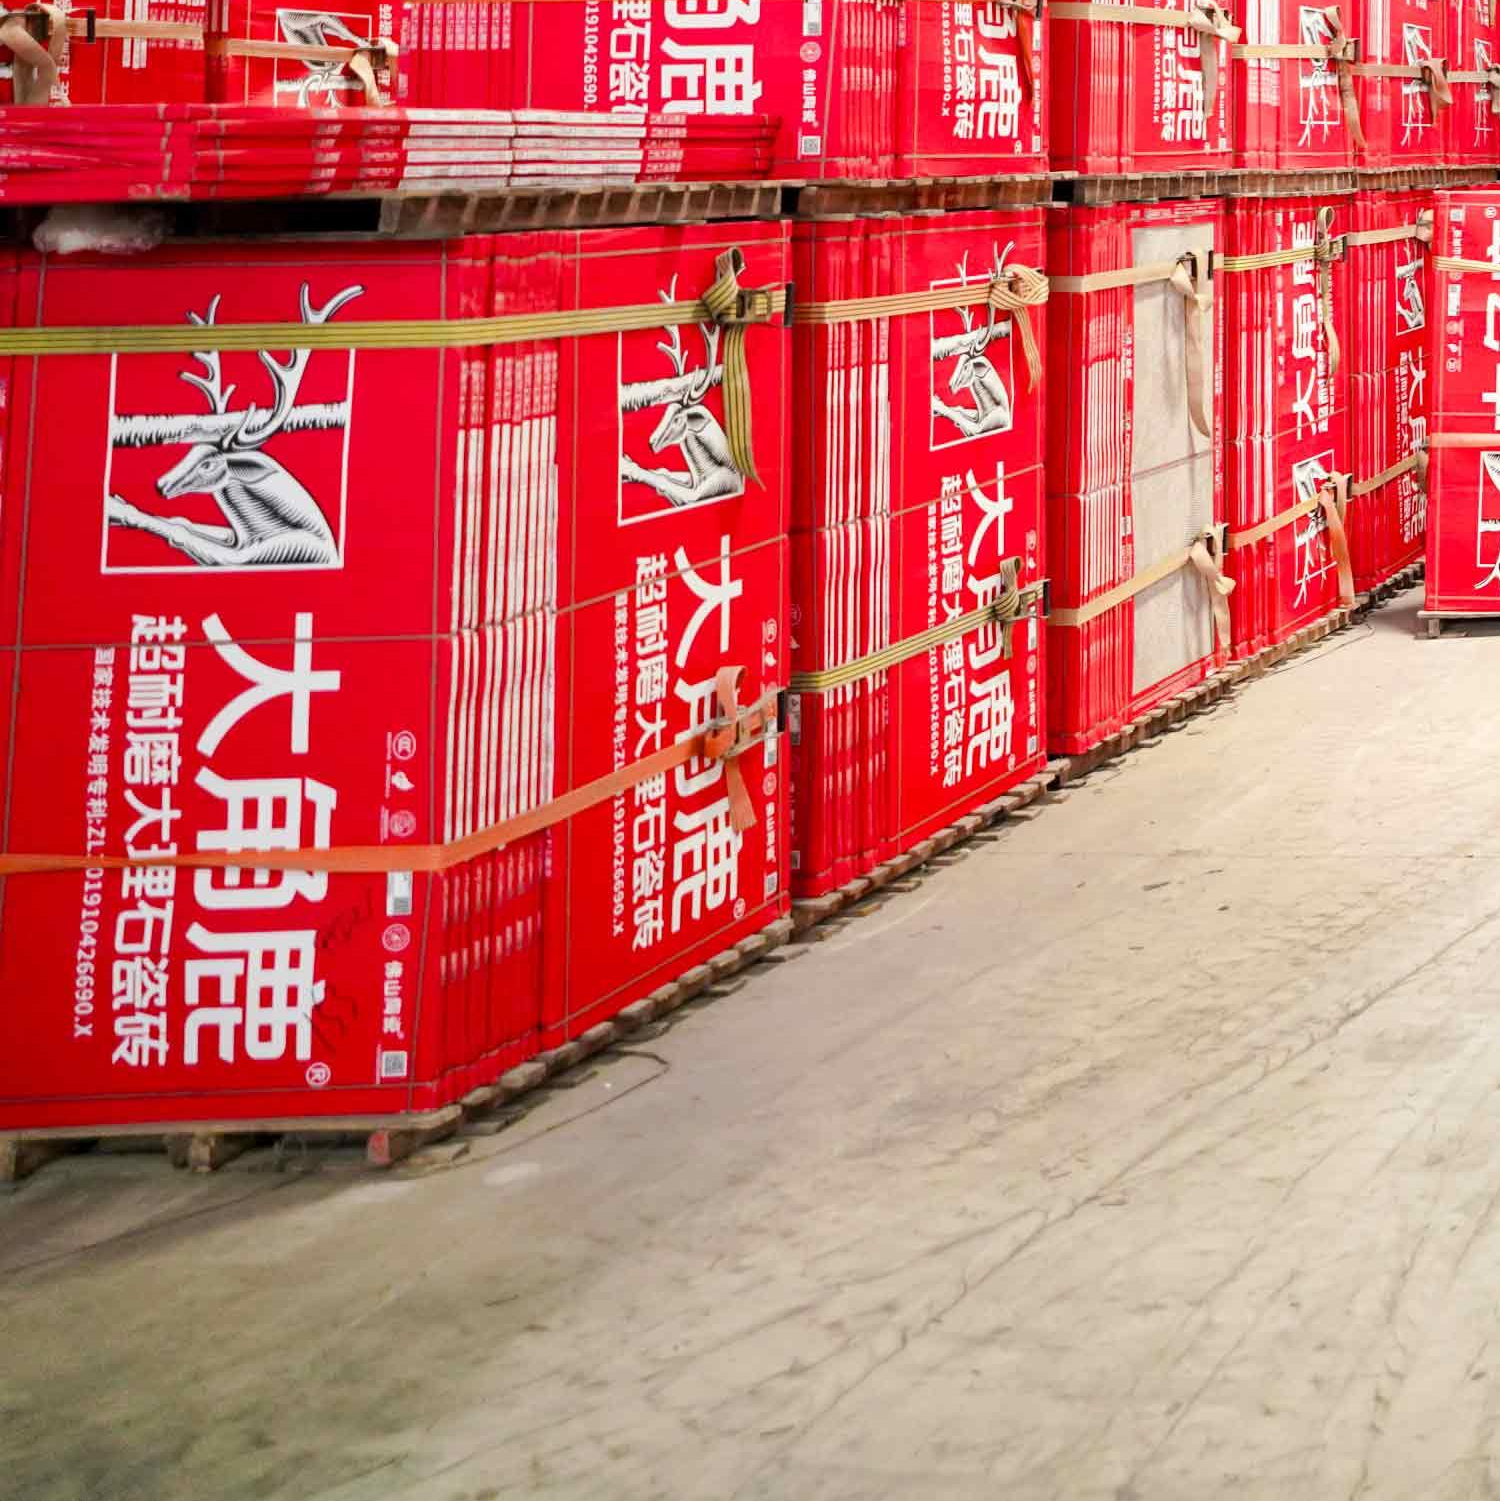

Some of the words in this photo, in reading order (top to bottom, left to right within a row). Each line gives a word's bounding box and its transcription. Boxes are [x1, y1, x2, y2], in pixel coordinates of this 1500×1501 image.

[1291, 221, 1316, 440] 大角鹿
[613, 590, 629, 937] 国家技术发明专利:ZL1910426690.X
[966, 461, 1015, 777] 大角鹿
[73, 647, 115, 1037] 国家技术发明专利:ZL01910426690.X
[112, 614, 187, 1067] 超耐磨大理石瓷砖
[184, 612, 341, 1065] 大角鹿
